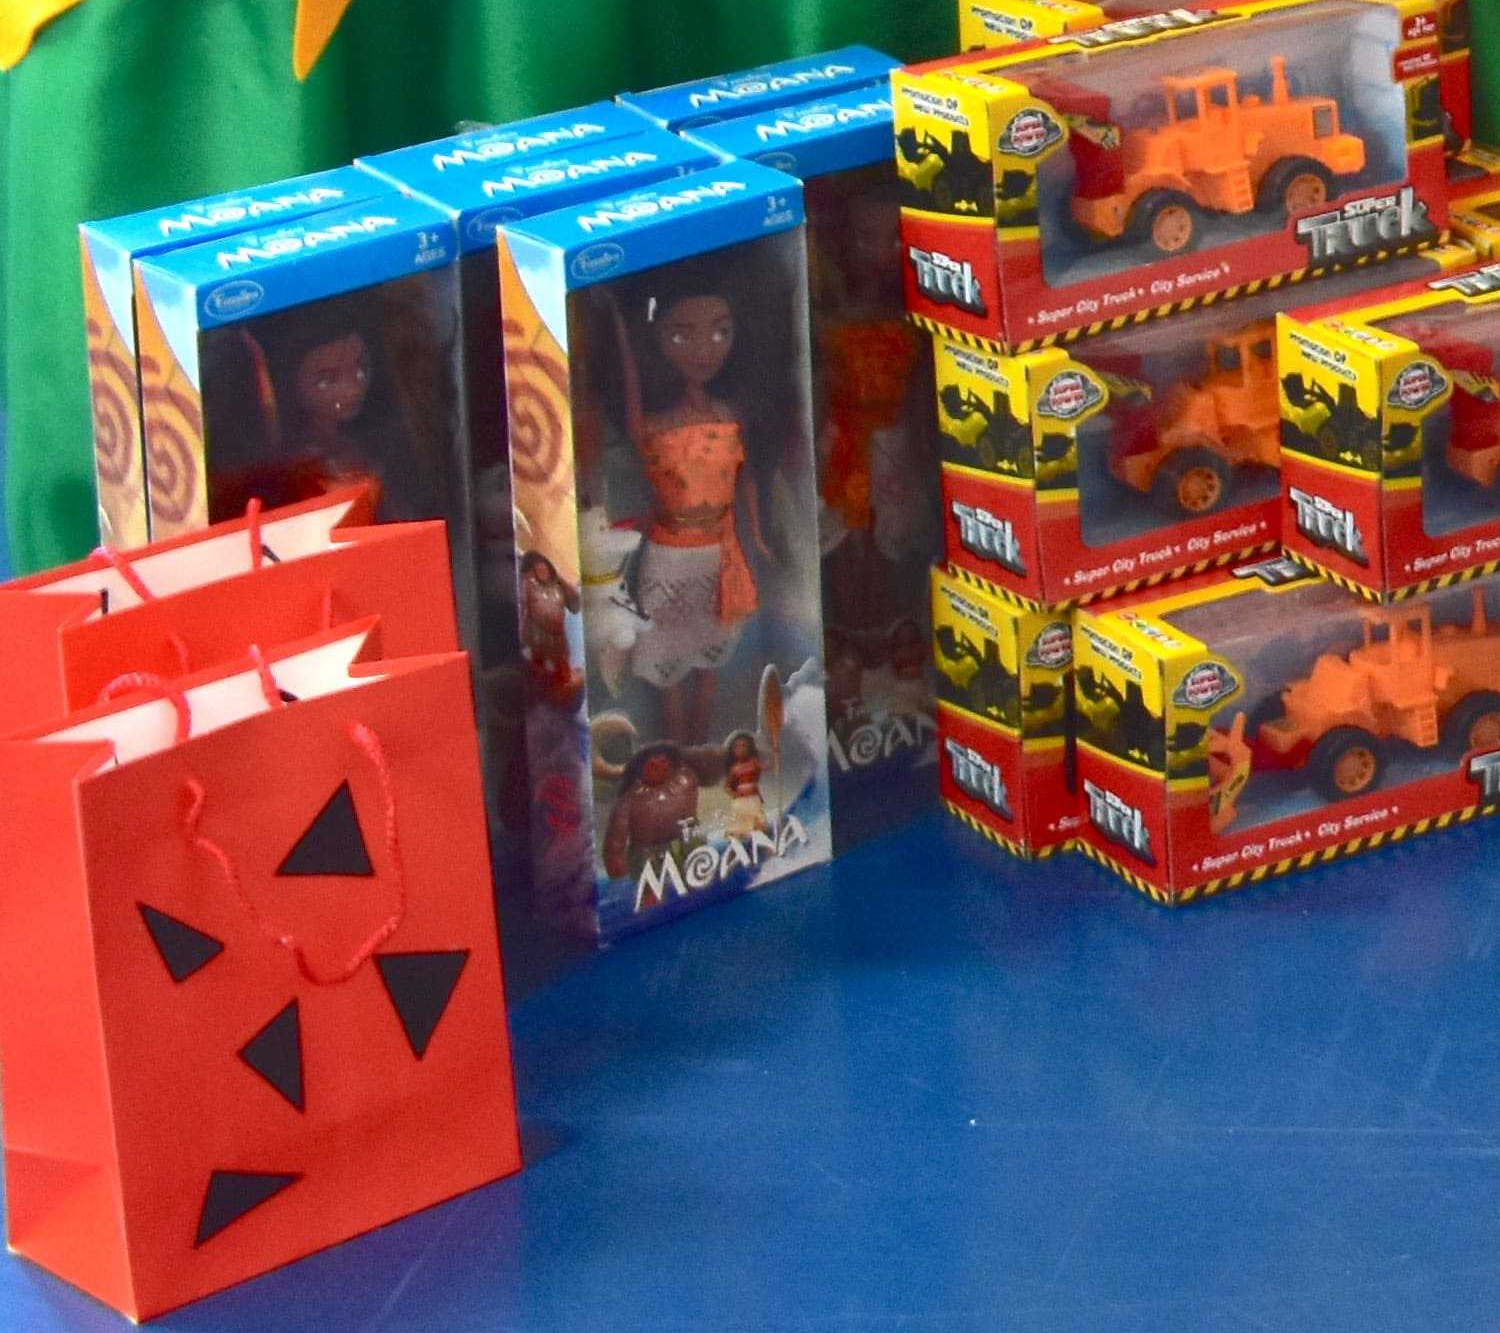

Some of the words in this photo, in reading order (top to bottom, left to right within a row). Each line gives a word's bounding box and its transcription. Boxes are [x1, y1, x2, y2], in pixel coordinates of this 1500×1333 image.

[690, 63, 854, 108] MOANA
[756, 100, 892, 142] MOAN
[433, 123, 604, 172] MOANA
[482, 152, 657, 199] MOANA
[161, 187, 344, 235] MOANA
[577, 181, 746, 232] MOANA
[217, 216, 396, 270] MOANA
[1037, 306, 1074, 326] Super
[1075, 298, 1099, 315] City
[1102, 289, 1137, 306] Truck
[1150, 279, 1173, 296] City
[1175, 269, 1221, 288] Service
[1073, 565, 1110, 583] Super
[1112, 557, 1136, 573] City
[1138, 545, 1173, 564] Truck
[1187, 536, 1211, 552] City
[1212, 524, 1257, 542] Service
[1413, 552, 1448, 572] Super
[1450, 544, 1473, 561] City
[635, 813, 808, 913] MOANA
[1202, 852, 1238, 872] Super
[1240, 842, 1265, 860] City
[1267, 831, 1303, 850] Truck
[1318, 821, 1341, 839] City
[1342, 809, 1390, 830] Service
